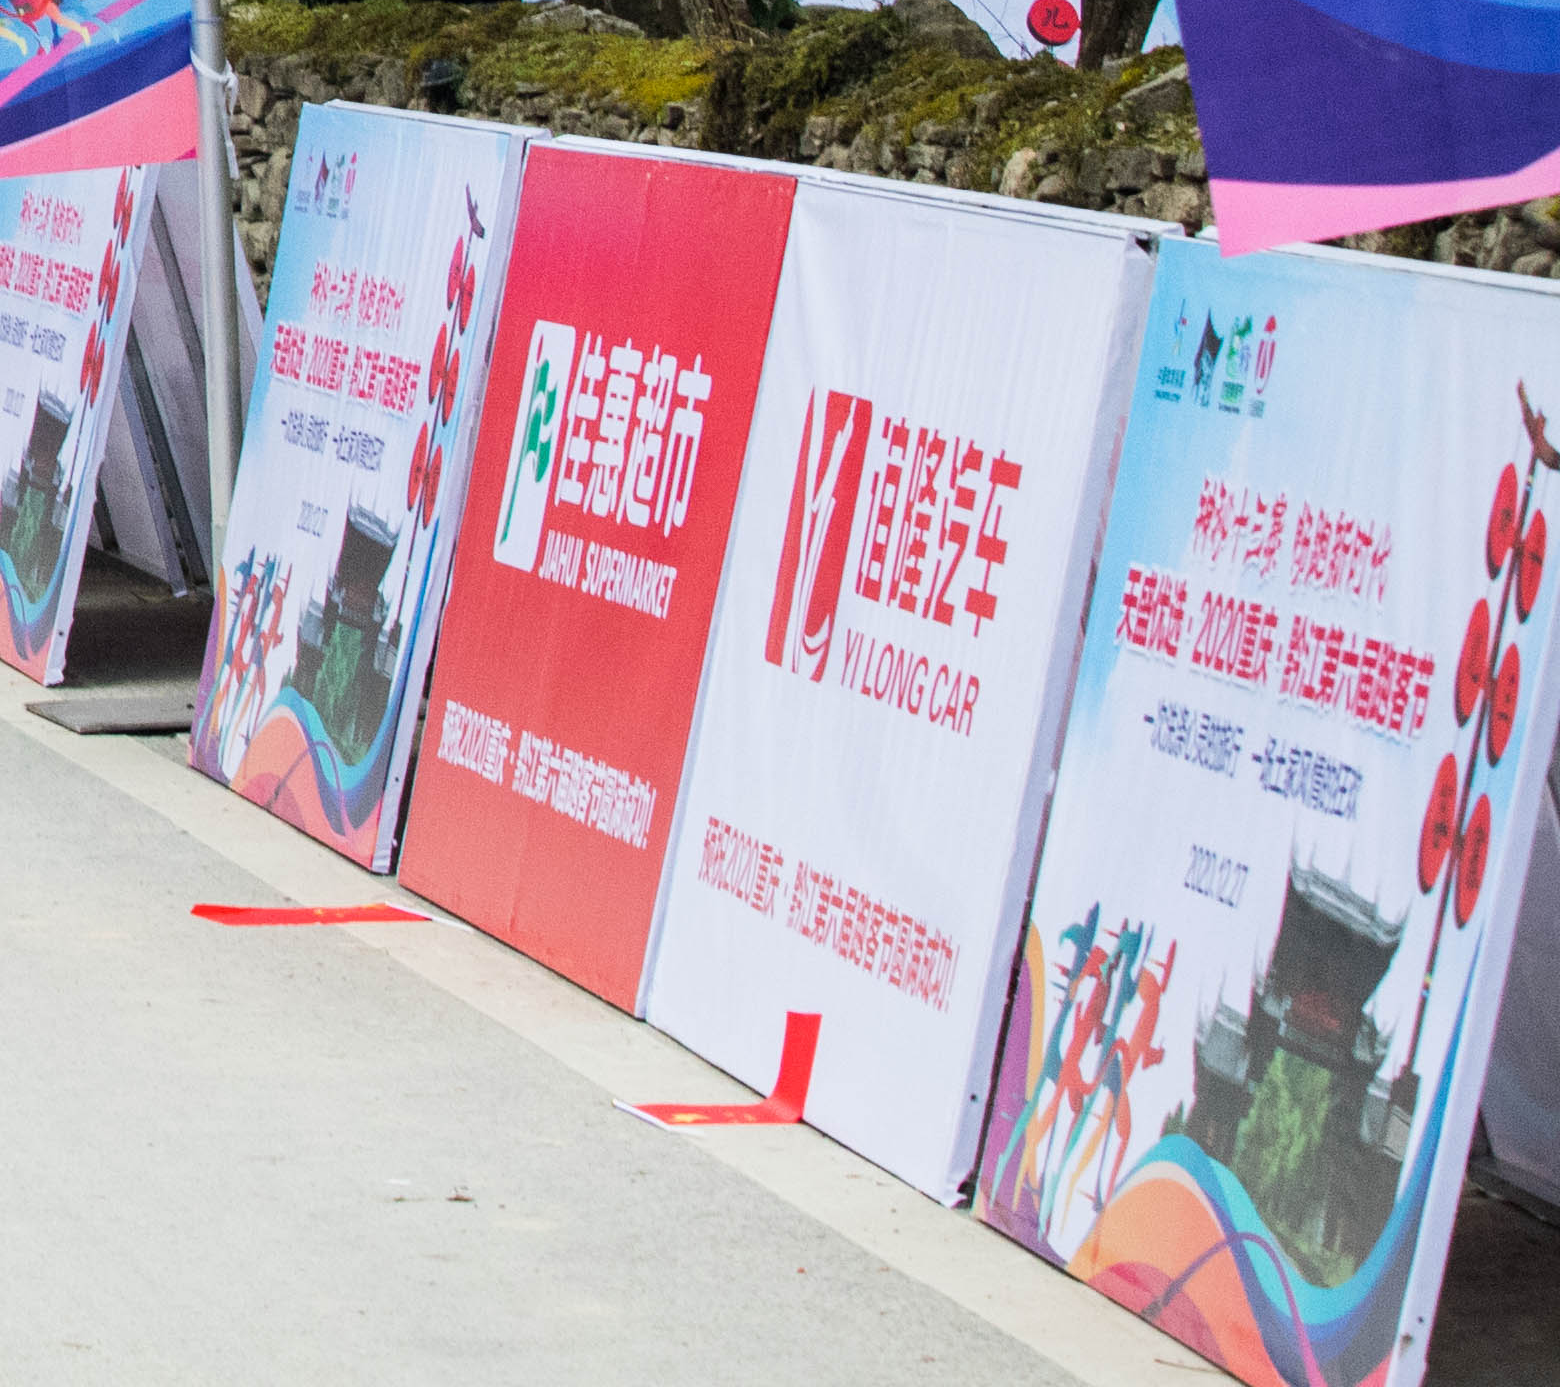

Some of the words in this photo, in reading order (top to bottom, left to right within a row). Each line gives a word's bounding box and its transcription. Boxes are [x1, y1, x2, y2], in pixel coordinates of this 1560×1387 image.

[553, 331, 715, 533] 佳惠超市
[538, 527, 581, 591] JIAHUI
[581, 542, 679, 622] SUPERMARKET
[853, 415, 1026, 642] 谊隆汽车
[839, 629, 865, 694] YI
[862, 639, 929, 720] LONG
[928, 667, 982, 738] CAR
[1115, 563, 1436, 740] 天盛优选·2020重庆·黔江第六届跑客节
